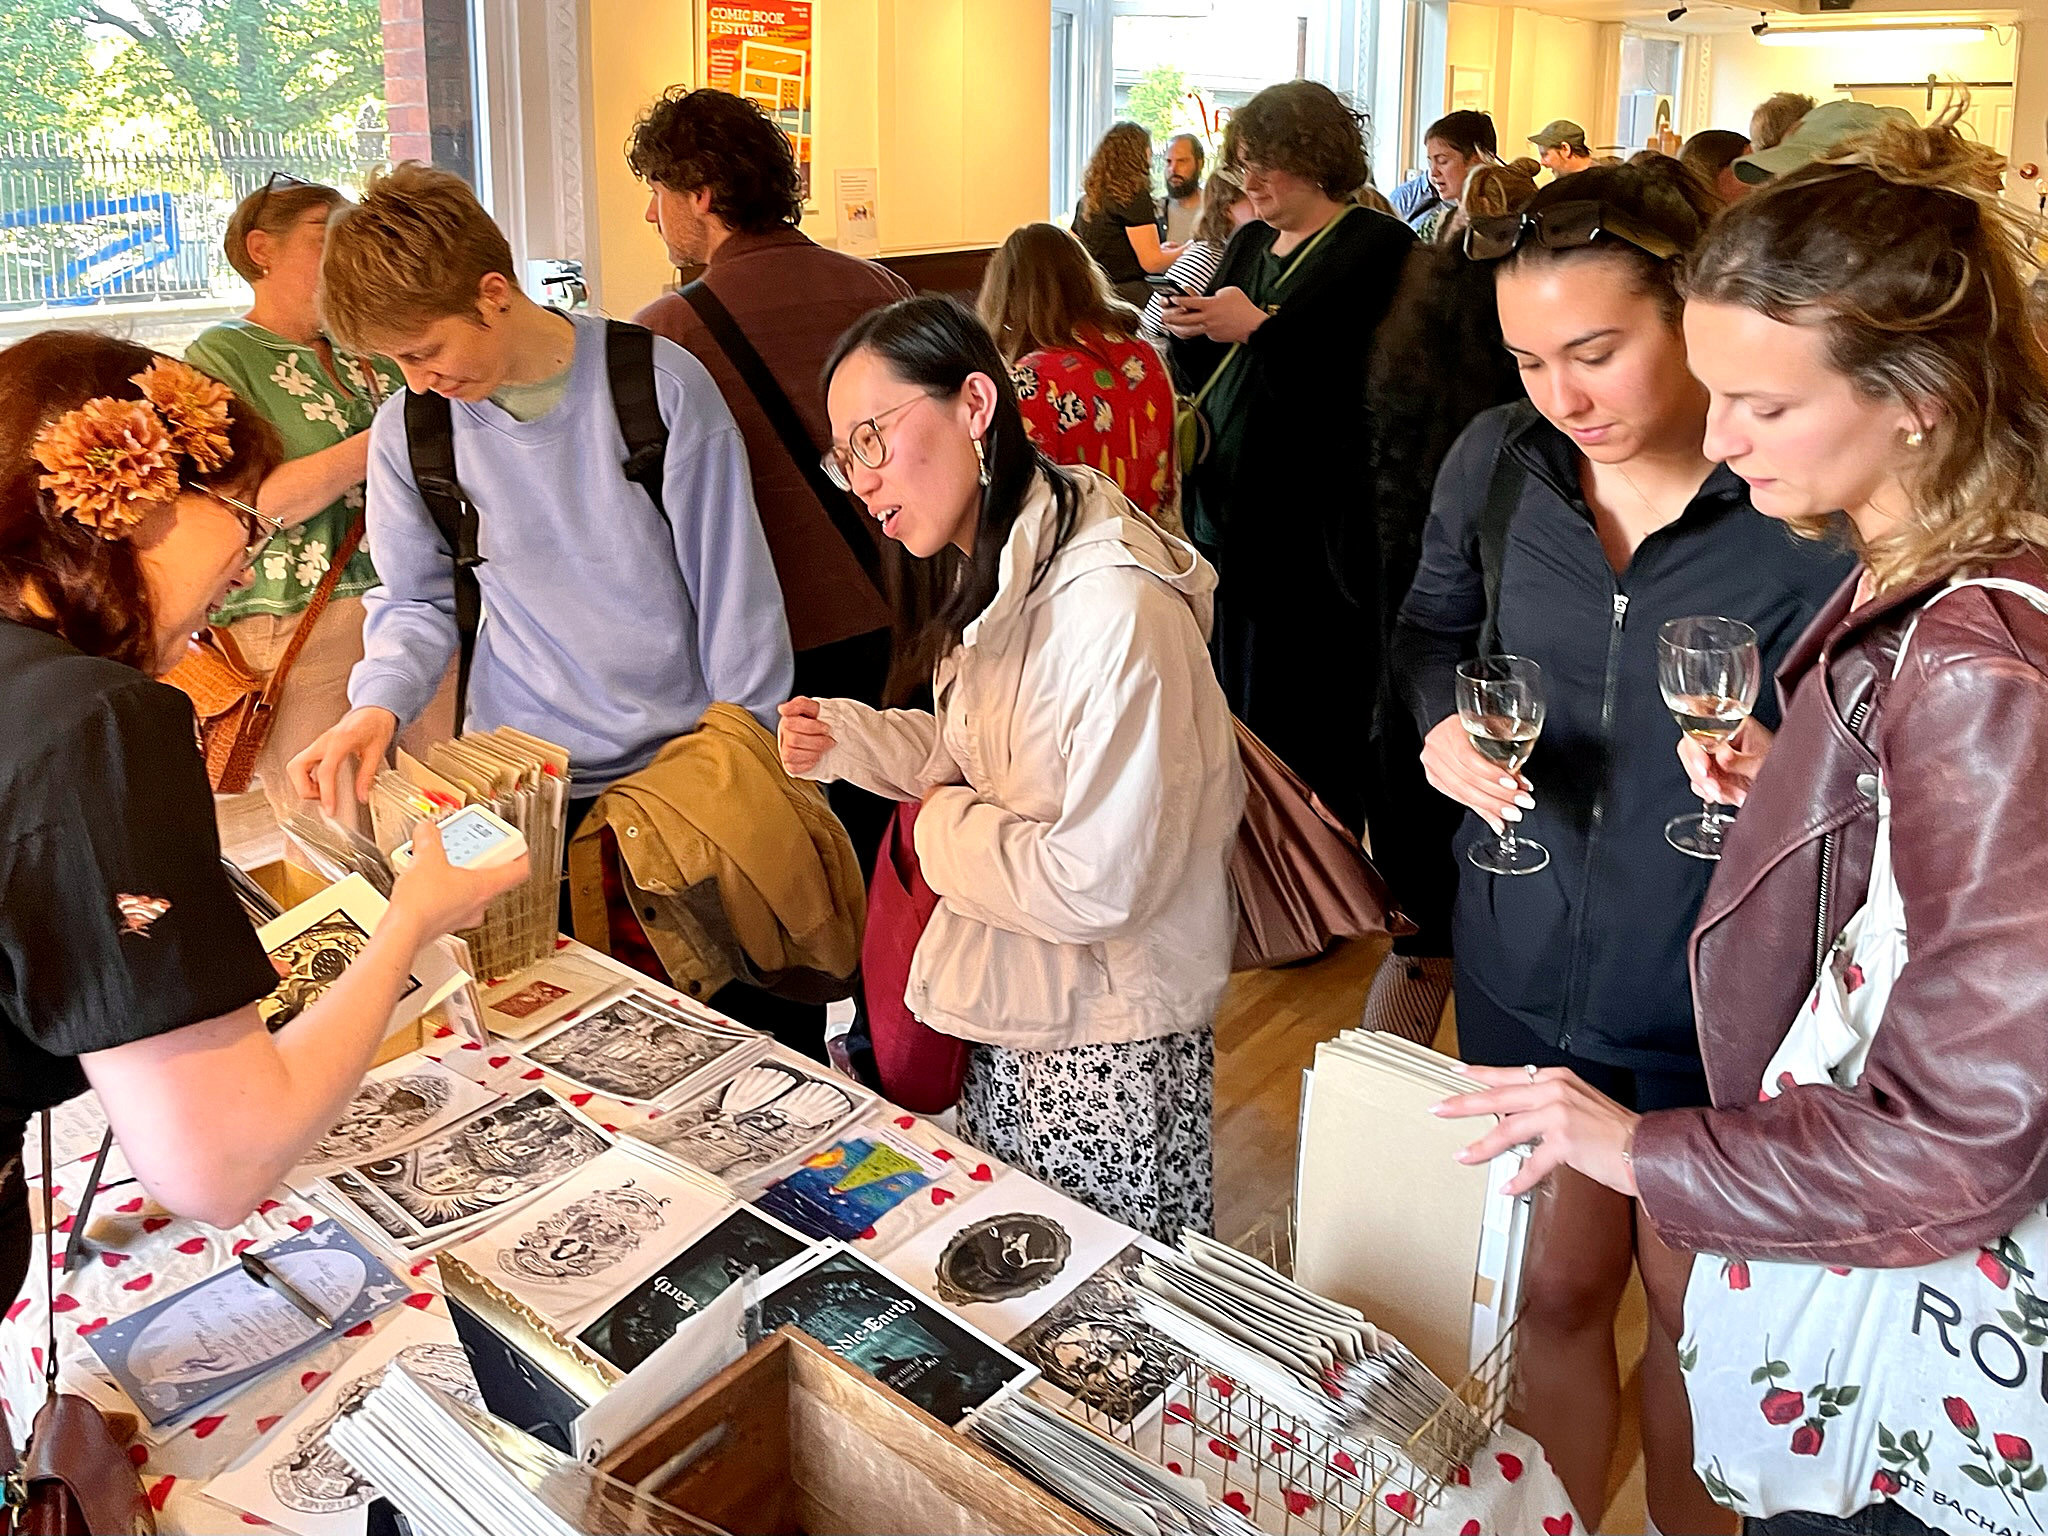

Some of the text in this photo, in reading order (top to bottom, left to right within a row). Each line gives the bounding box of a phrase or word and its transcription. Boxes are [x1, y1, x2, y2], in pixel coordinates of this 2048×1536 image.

[710, 7, 785, 25] COMIC BOOK
[710, 20, 768, 37] FESTIVAL
[1911, 1281, 2048, 1404] RO
